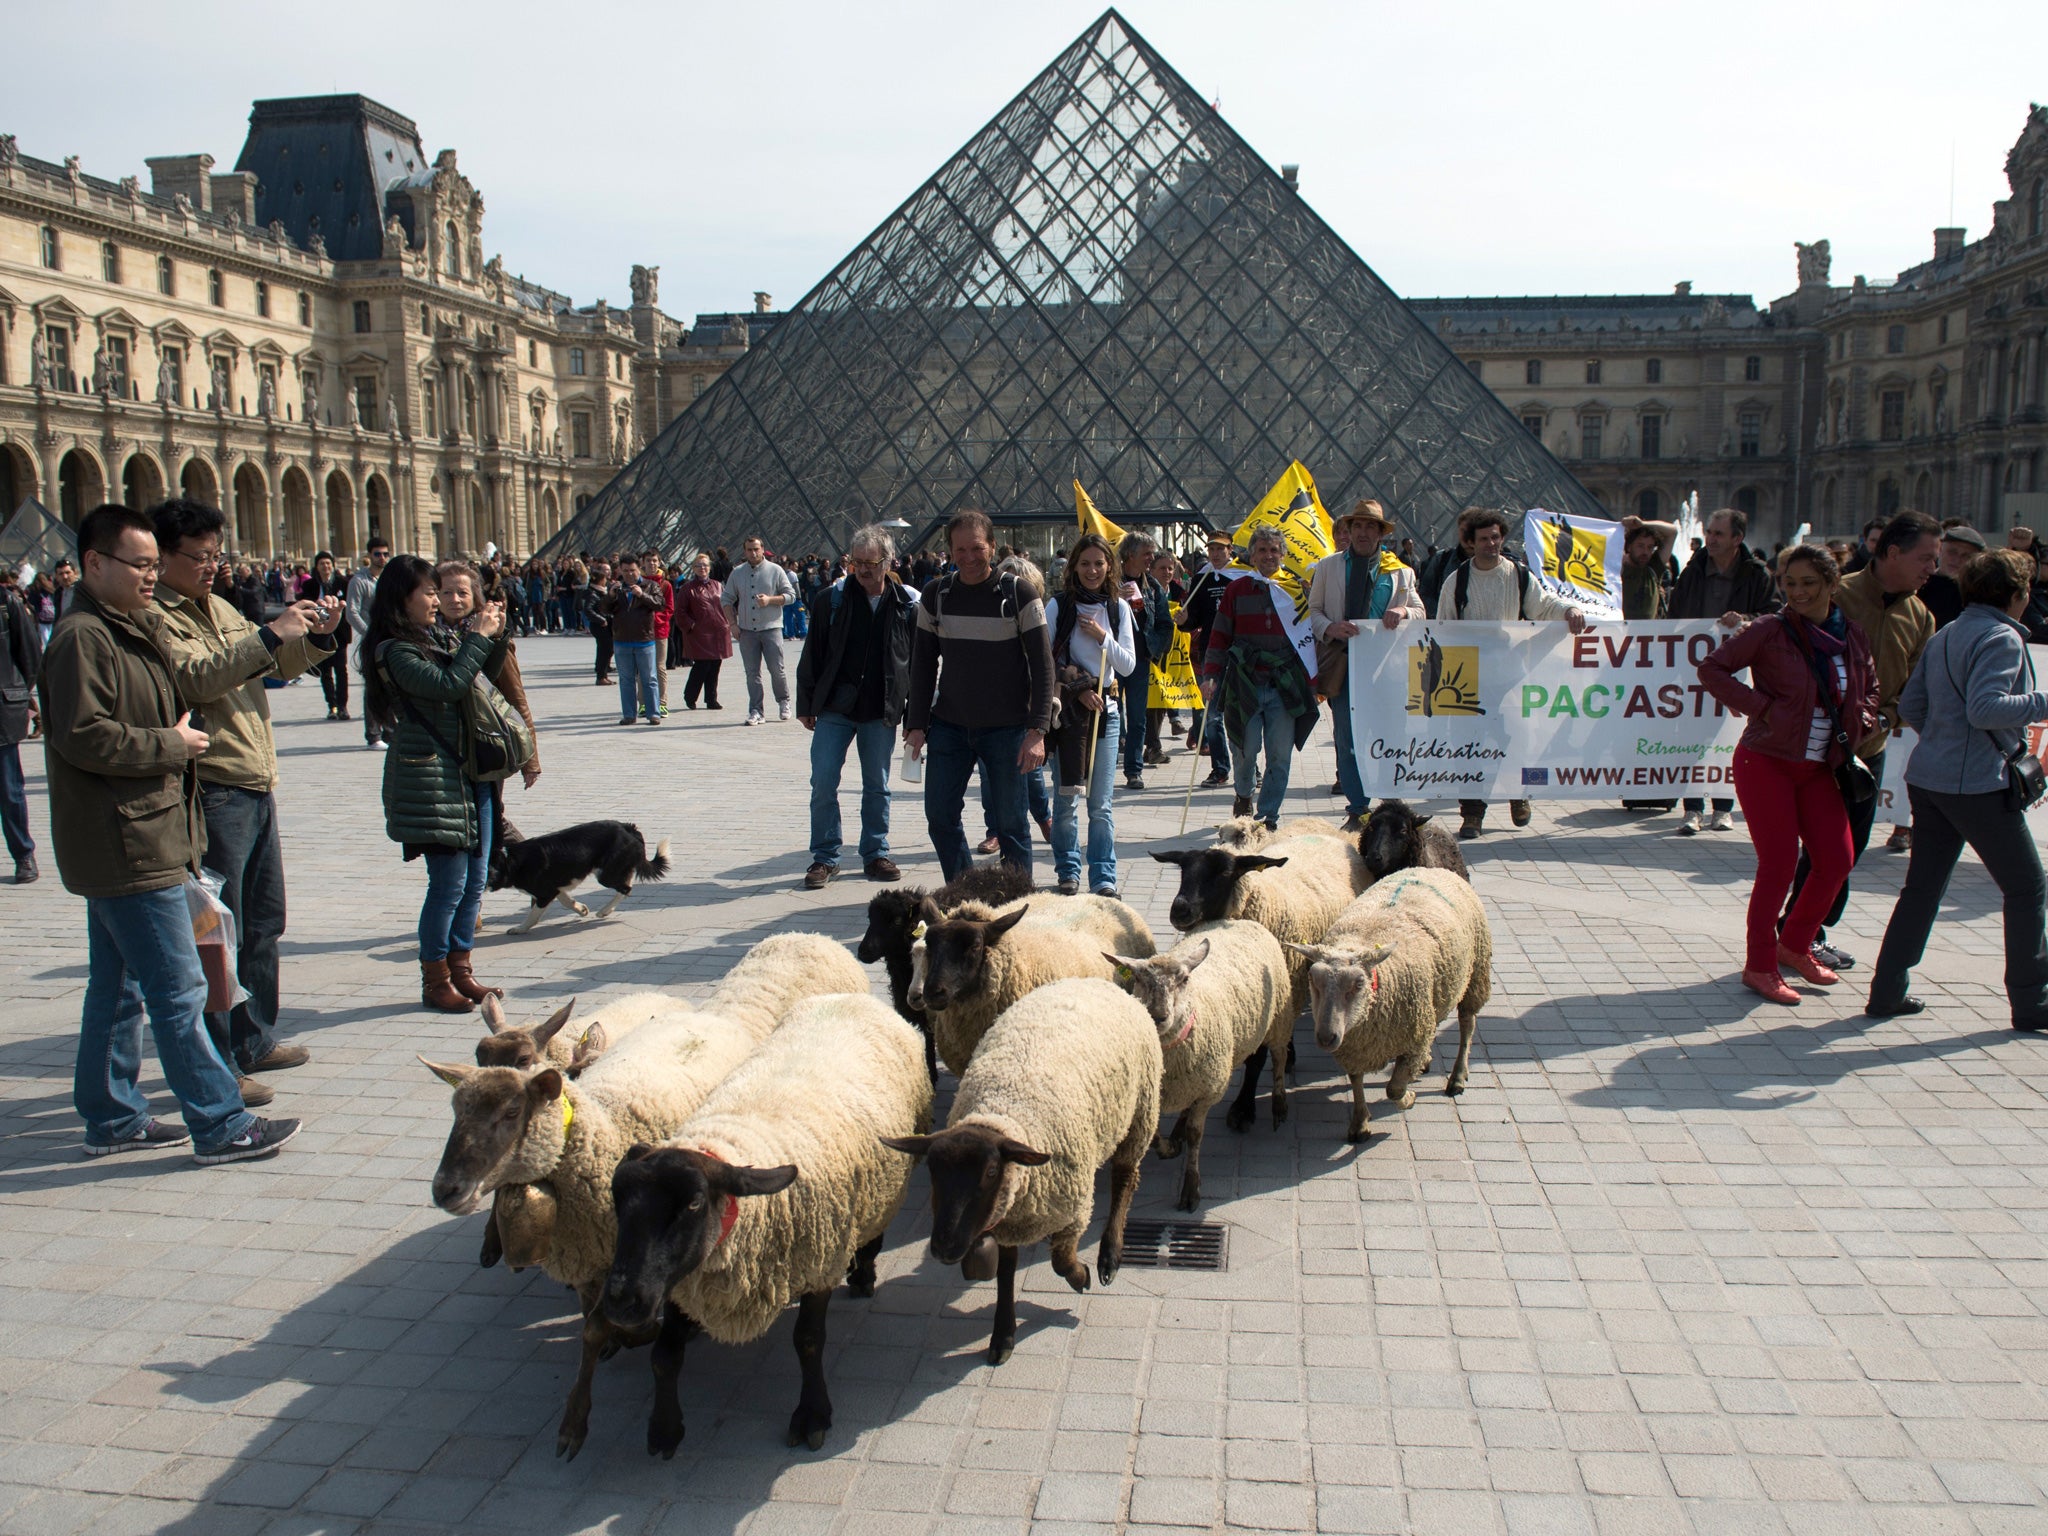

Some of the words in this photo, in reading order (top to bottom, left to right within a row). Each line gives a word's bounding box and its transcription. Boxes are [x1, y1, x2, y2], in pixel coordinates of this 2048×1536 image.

[1572, 625, 1730, 668] ÉVITO
[1370, 737, 1506, 766] Confédération
[1393, 762, 1486, 791] Paysanne
